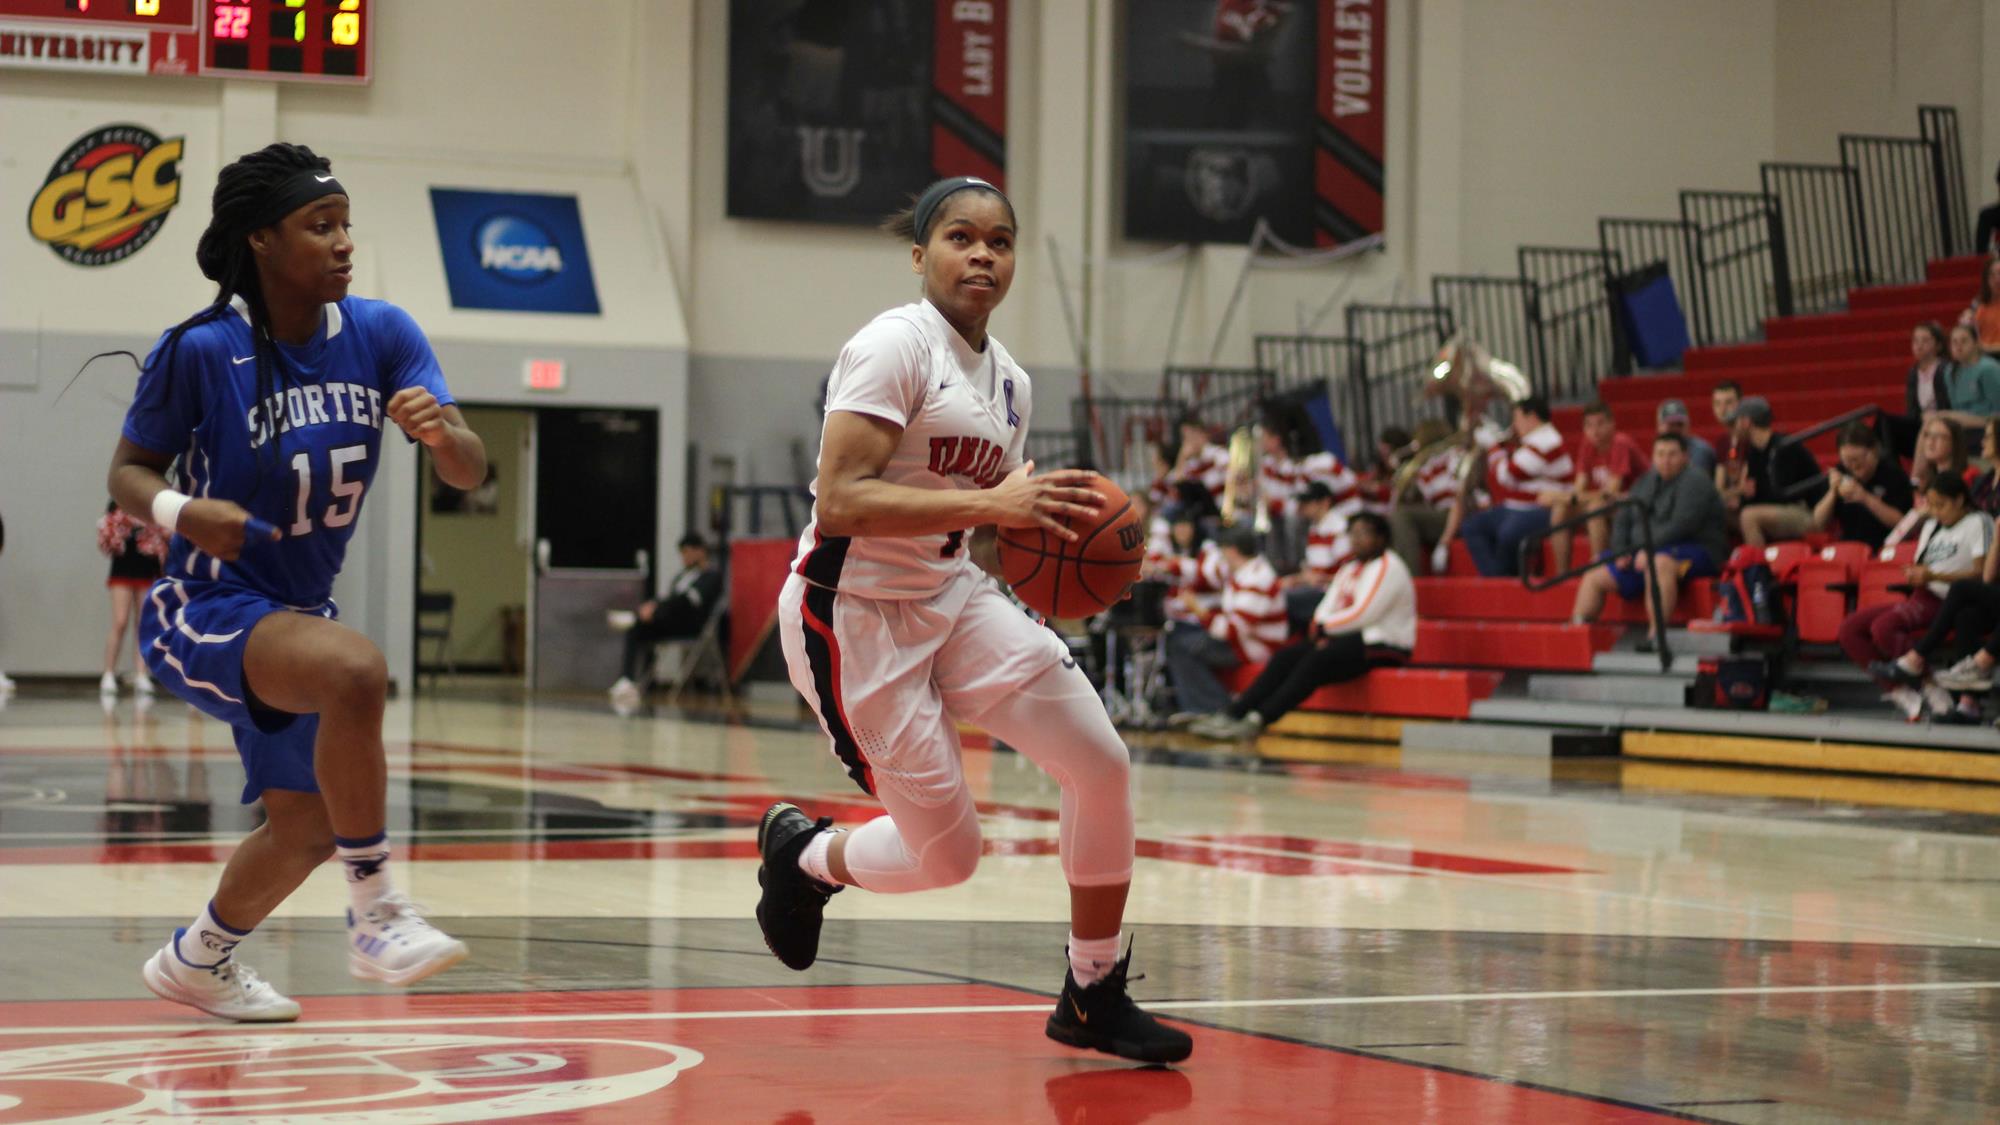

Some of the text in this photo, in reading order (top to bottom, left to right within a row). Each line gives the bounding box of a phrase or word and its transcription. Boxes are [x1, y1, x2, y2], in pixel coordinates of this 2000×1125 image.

[214, 5, 251, 38] 22
[962, 31, 993, 95] LADY
[29, 136, 184, 243] GSC
[481, 243, 563, 272] NCAA
[291, 444, 368, 536] 15
[927, 435, 1011, 489] UNIO
